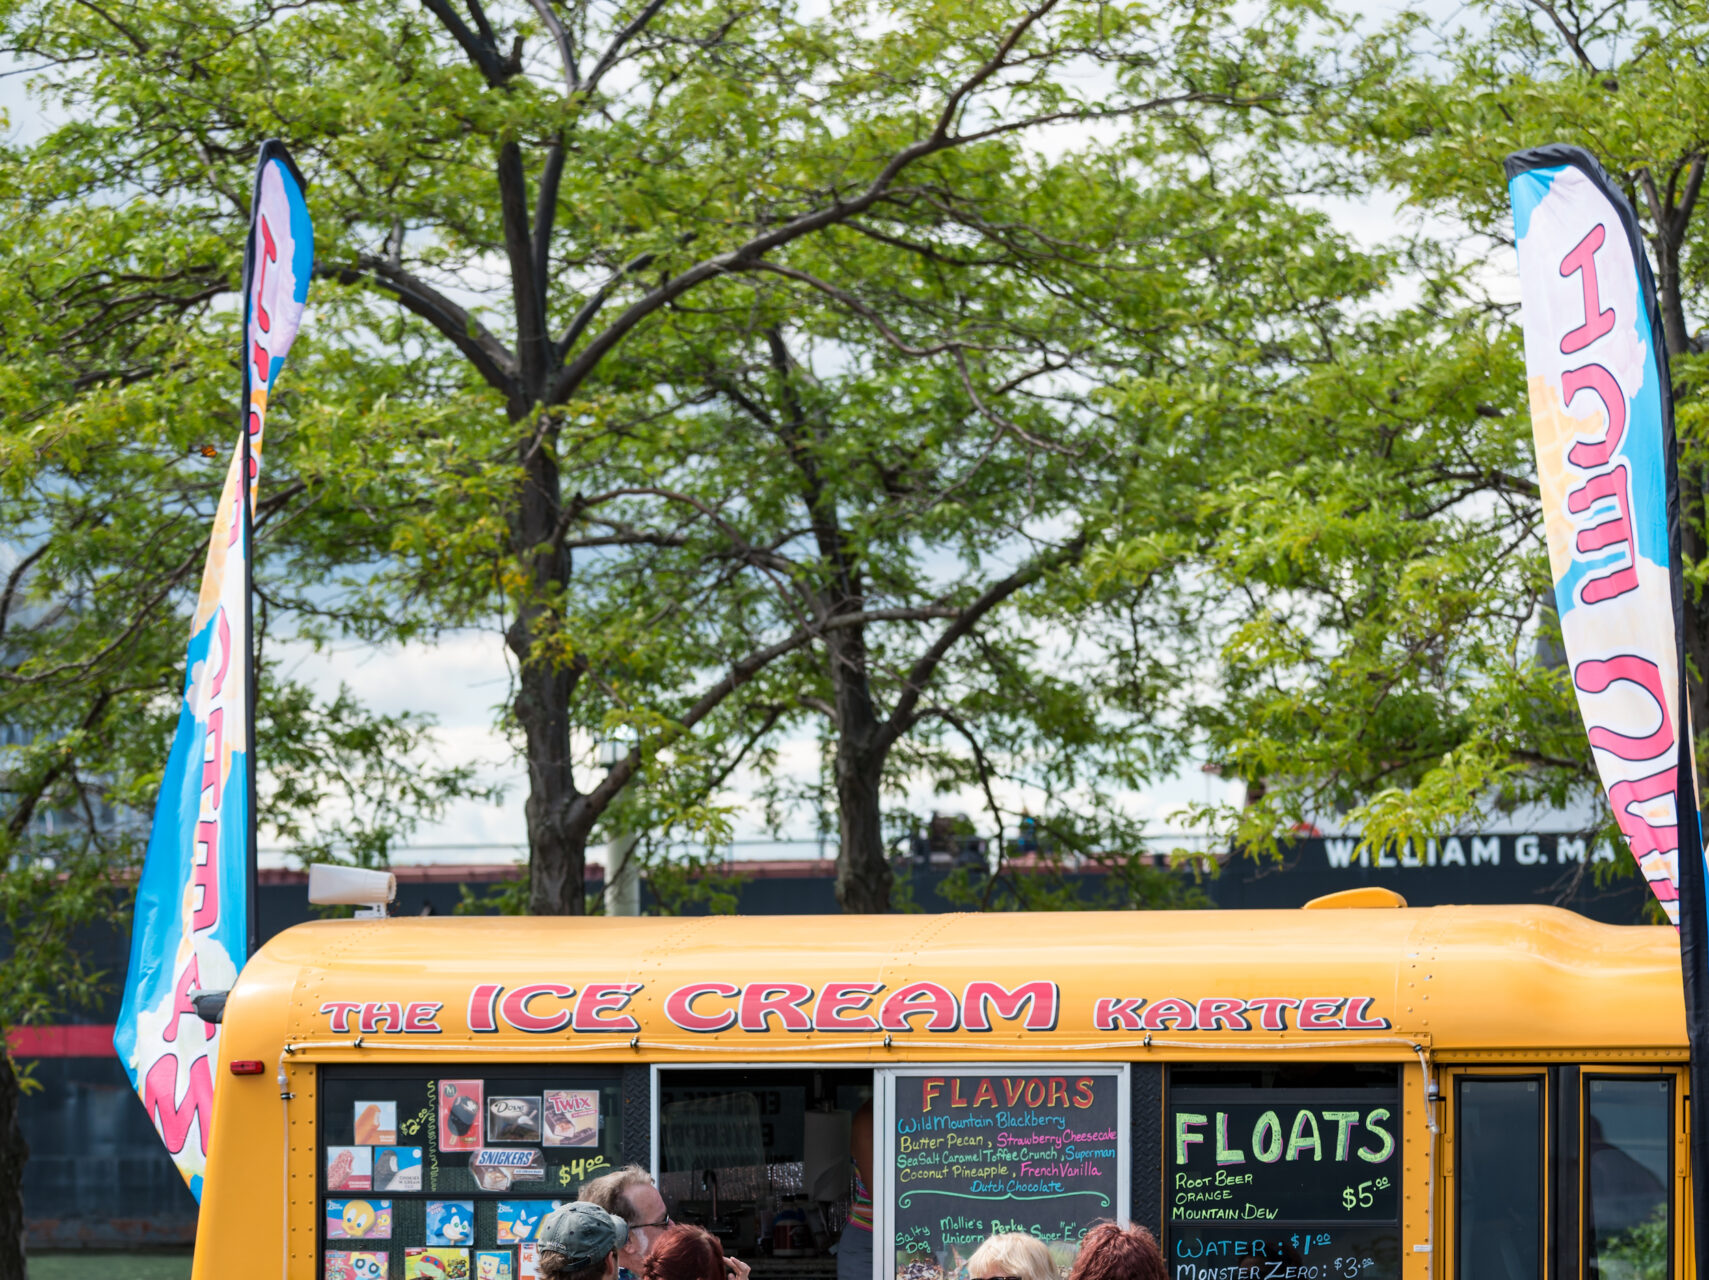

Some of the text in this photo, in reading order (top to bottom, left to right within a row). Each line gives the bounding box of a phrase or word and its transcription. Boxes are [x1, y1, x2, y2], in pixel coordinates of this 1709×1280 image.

[1514, 836, 1549, 865] G.
[1556, 836, 1616, 864] MA
[320, 981, 1393, 1034] THE ICE CREAM KARTEL
[922, 1077, 1095, 1112] FLAVORS
[898, 1110, 1066, 1134] Wild Mountain Blackberry
[901, 1135, 945, 1153] Butter
[997, 1131, 1062, 1149] Strawberry
[1062, 1128, 1117, 1145] Cheesecake
[1175, 1108, 1395, 1166] FLOATS
[478, 1150, 533, 1165] SNICKERS
[942, 1149, 982, 1164] Caramel
[983, 1149, 1019, 1163] Toffee
[1065, 1145, 1116, 1163] Superman
[900, 1166, 949, 1183] Coconut
[1020, 1161, 1058, 1177] French
[1059, 1162, 1102, 1177] Vanilla
[1215, 1169, 1253, 1187] BEER
[970, 1177, 1065, 1192] Dutch Chocolate
[1175, 1190, 1233, 1205] ORANGE
[1172, 1203, 1279, 1220] MOUNTAIN DEW
[940, 1216, 983, 1231] Mollie's
[896, 1225, 931, 1246] Salty
[941, 1232, 985, 1245] Unicorn
[1030, 1225, 1062, 1242] Super
[906, 1241, 931, 1254] Dog
